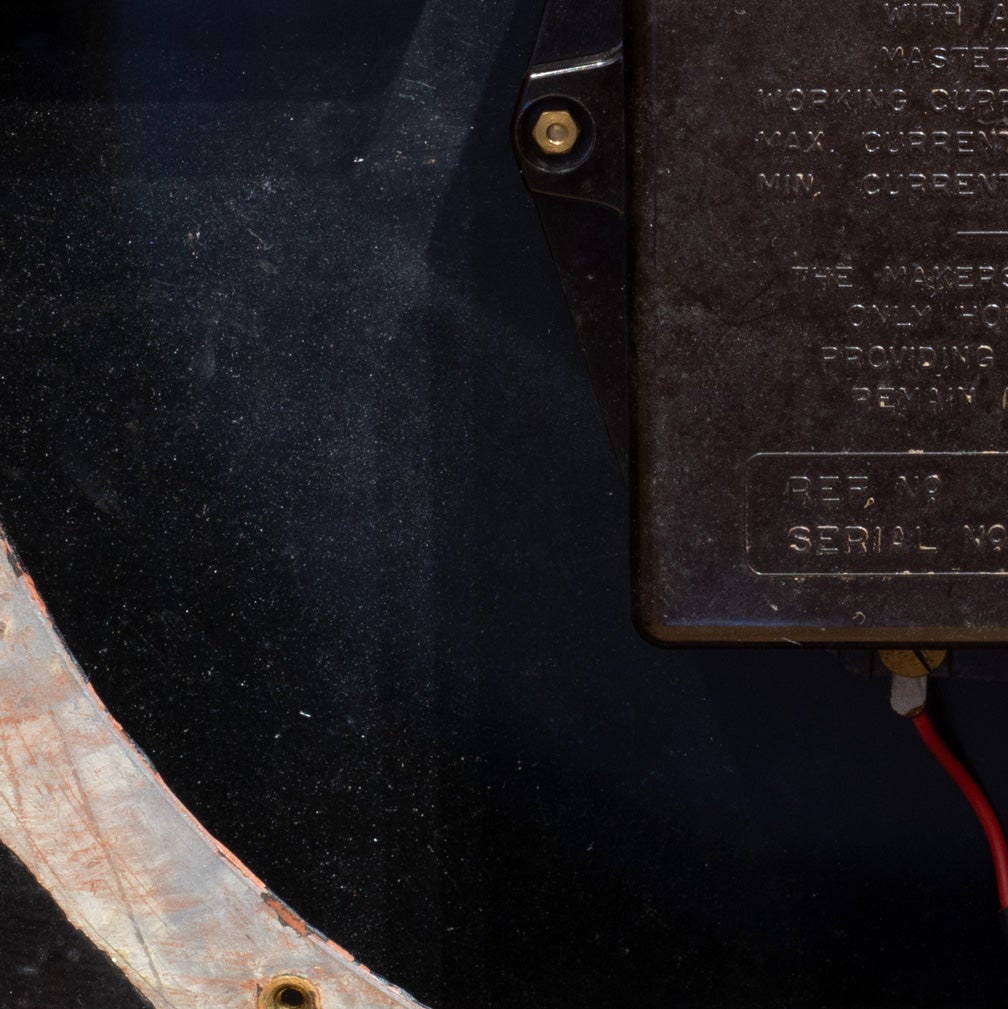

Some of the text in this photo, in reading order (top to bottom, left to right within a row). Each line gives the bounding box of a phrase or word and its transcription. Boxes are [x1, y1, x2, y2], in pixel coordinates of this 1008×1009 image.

[883, 2, 963, 26] WITH
[989, 2, 1006, 24] A
[757, 88, 908, 112] WORKING
[791, 265, 855, 288] THE
[846, 303, 934, 328] ONLY
[820, 344, 995, 369] PROVIDING
[851, 386, 979, 410] REMAIN
[787, 525, 938, 553] SERIAL
